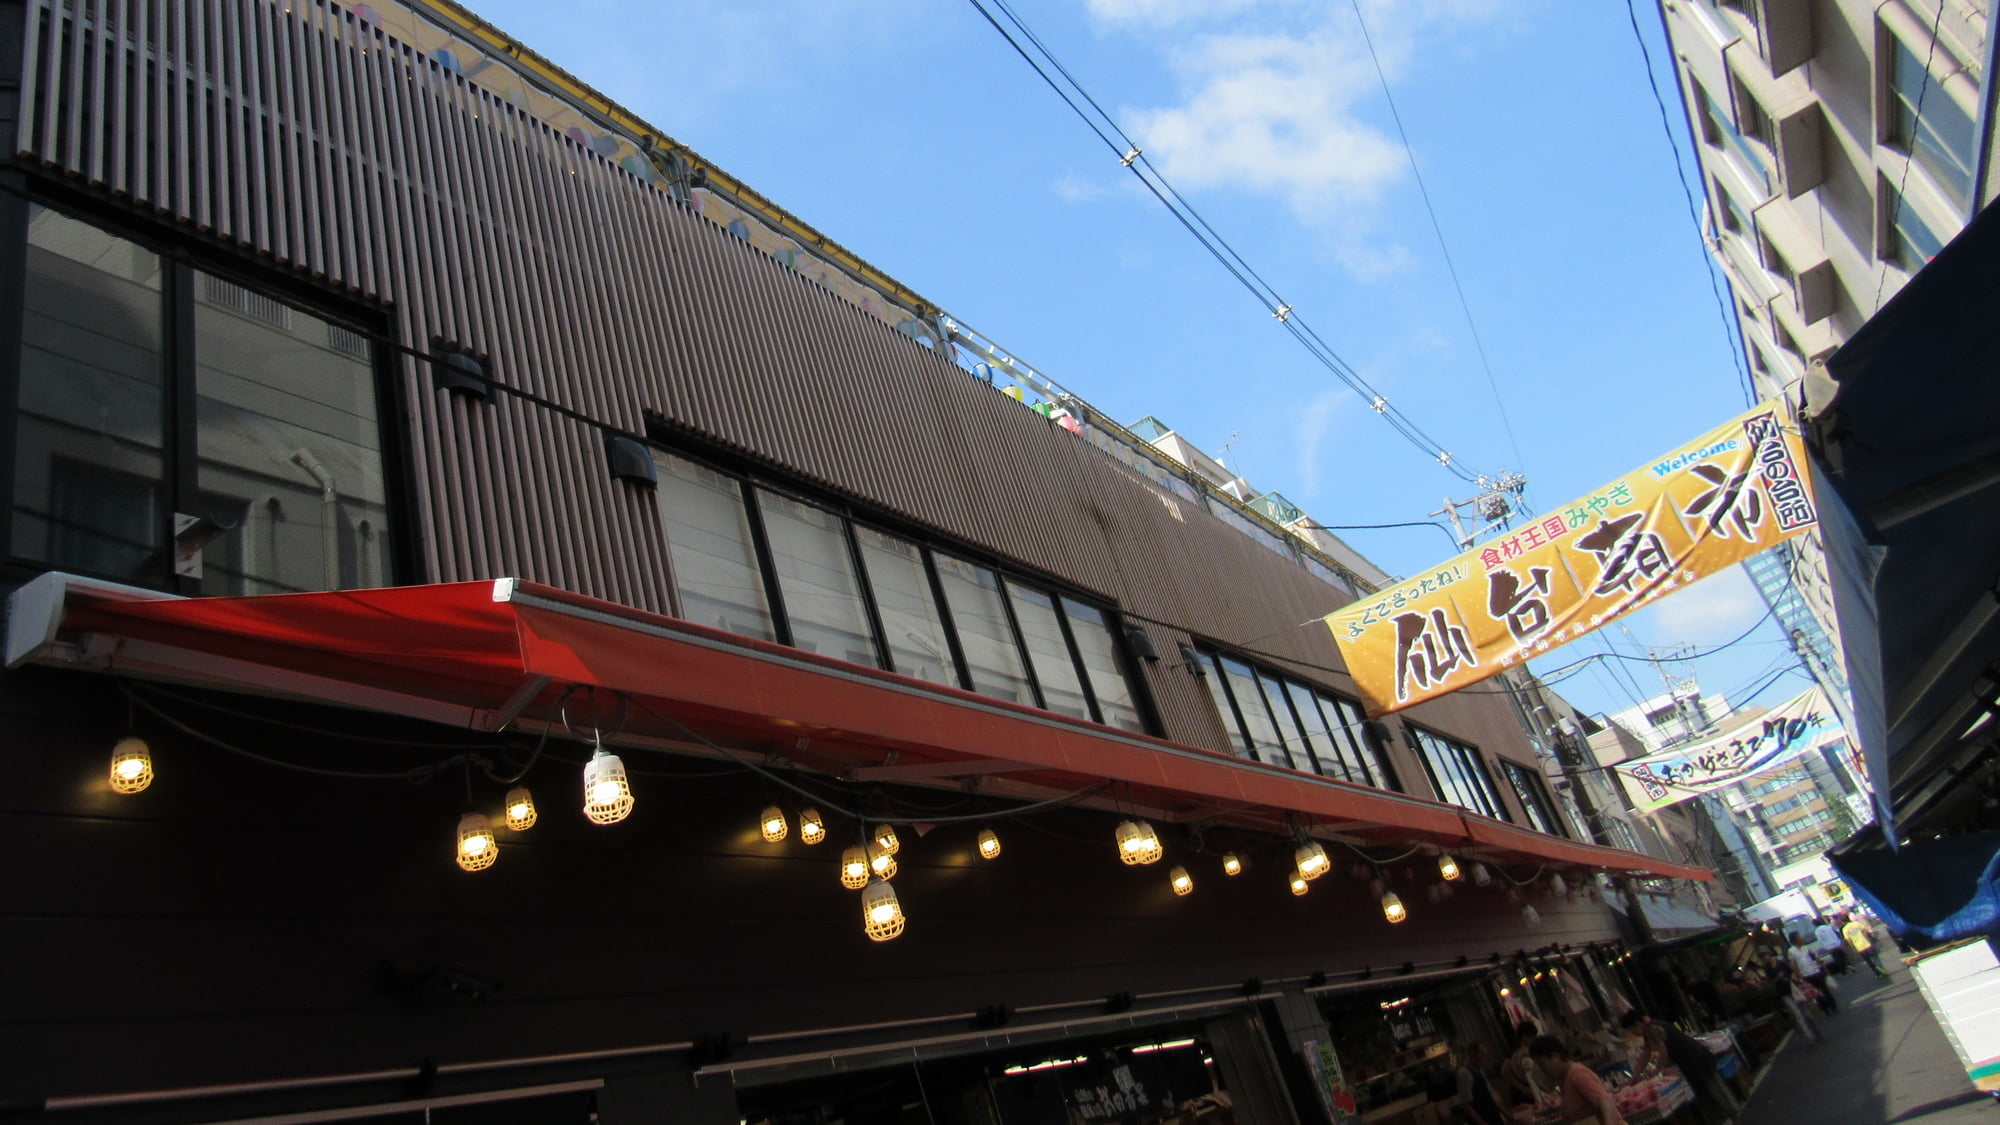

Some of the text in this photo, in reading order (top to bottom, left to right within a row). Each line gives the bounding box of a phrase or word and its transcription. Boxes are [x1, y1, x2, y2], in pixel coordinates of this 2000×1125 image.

[1651, 438, 1738, 477] Welcome
[1746, 418, 1811, 526] 仙台の台所
[1479, 482, 1633, 569] 食材王国みやぎ
[1391, 463, 1762, 702] 仙台朝市
[1661, 711, 1825, 786] おかげさまで70年
